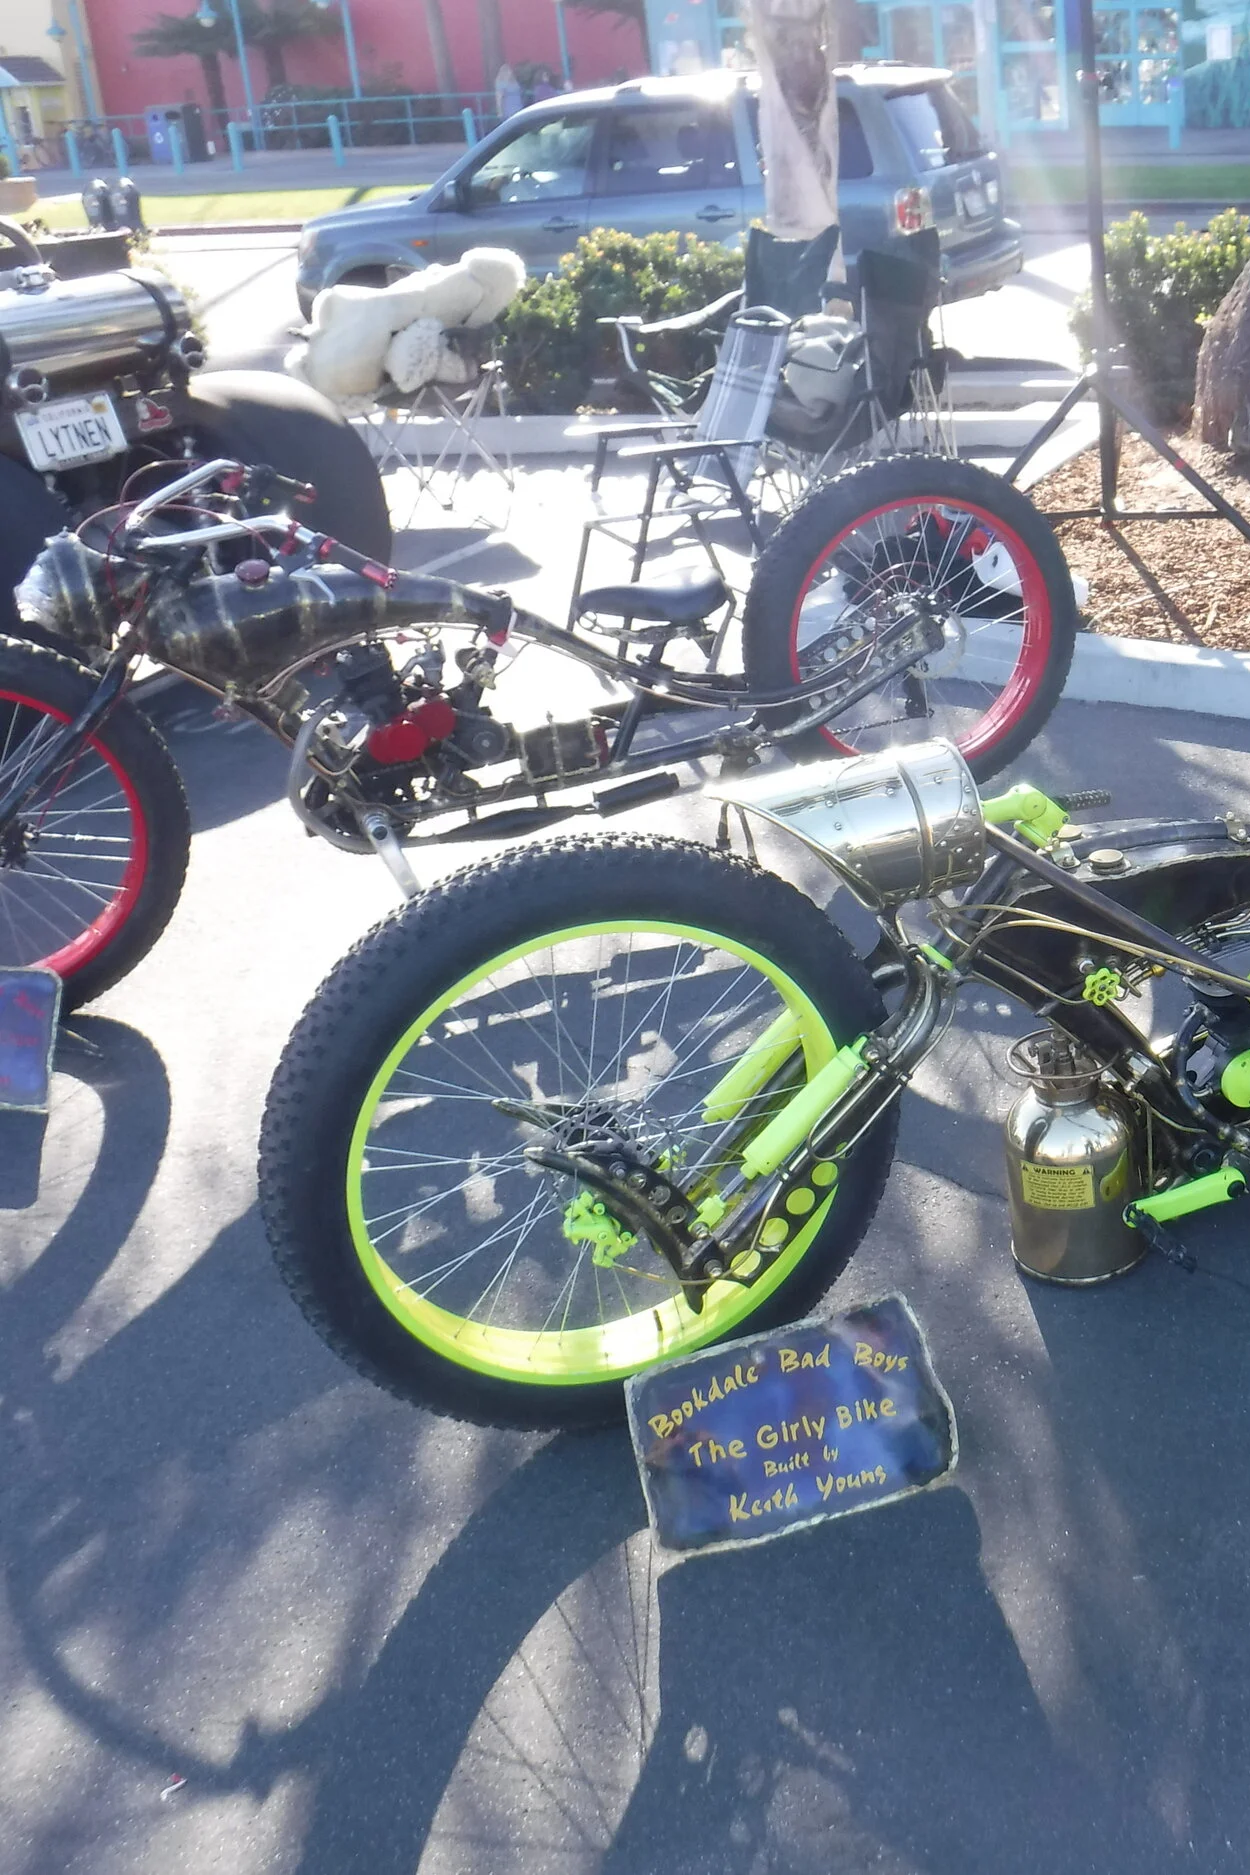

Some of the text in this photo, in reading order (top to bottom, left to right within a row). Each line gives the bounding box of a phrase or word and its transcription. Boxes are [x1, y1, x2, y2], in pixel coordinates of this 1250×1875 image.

[37, 416, 113, 458] LYTNEN
[1033, 1166, 1076, 1175] WARNING
[647, 1342, 909, 1439] Bookdale Bad Boys
[688, 1398, 897, 1467] The Girly Bike
[763, 1444, 838, 1477] Built by
[729, 1482, 799, 1523] Keith
